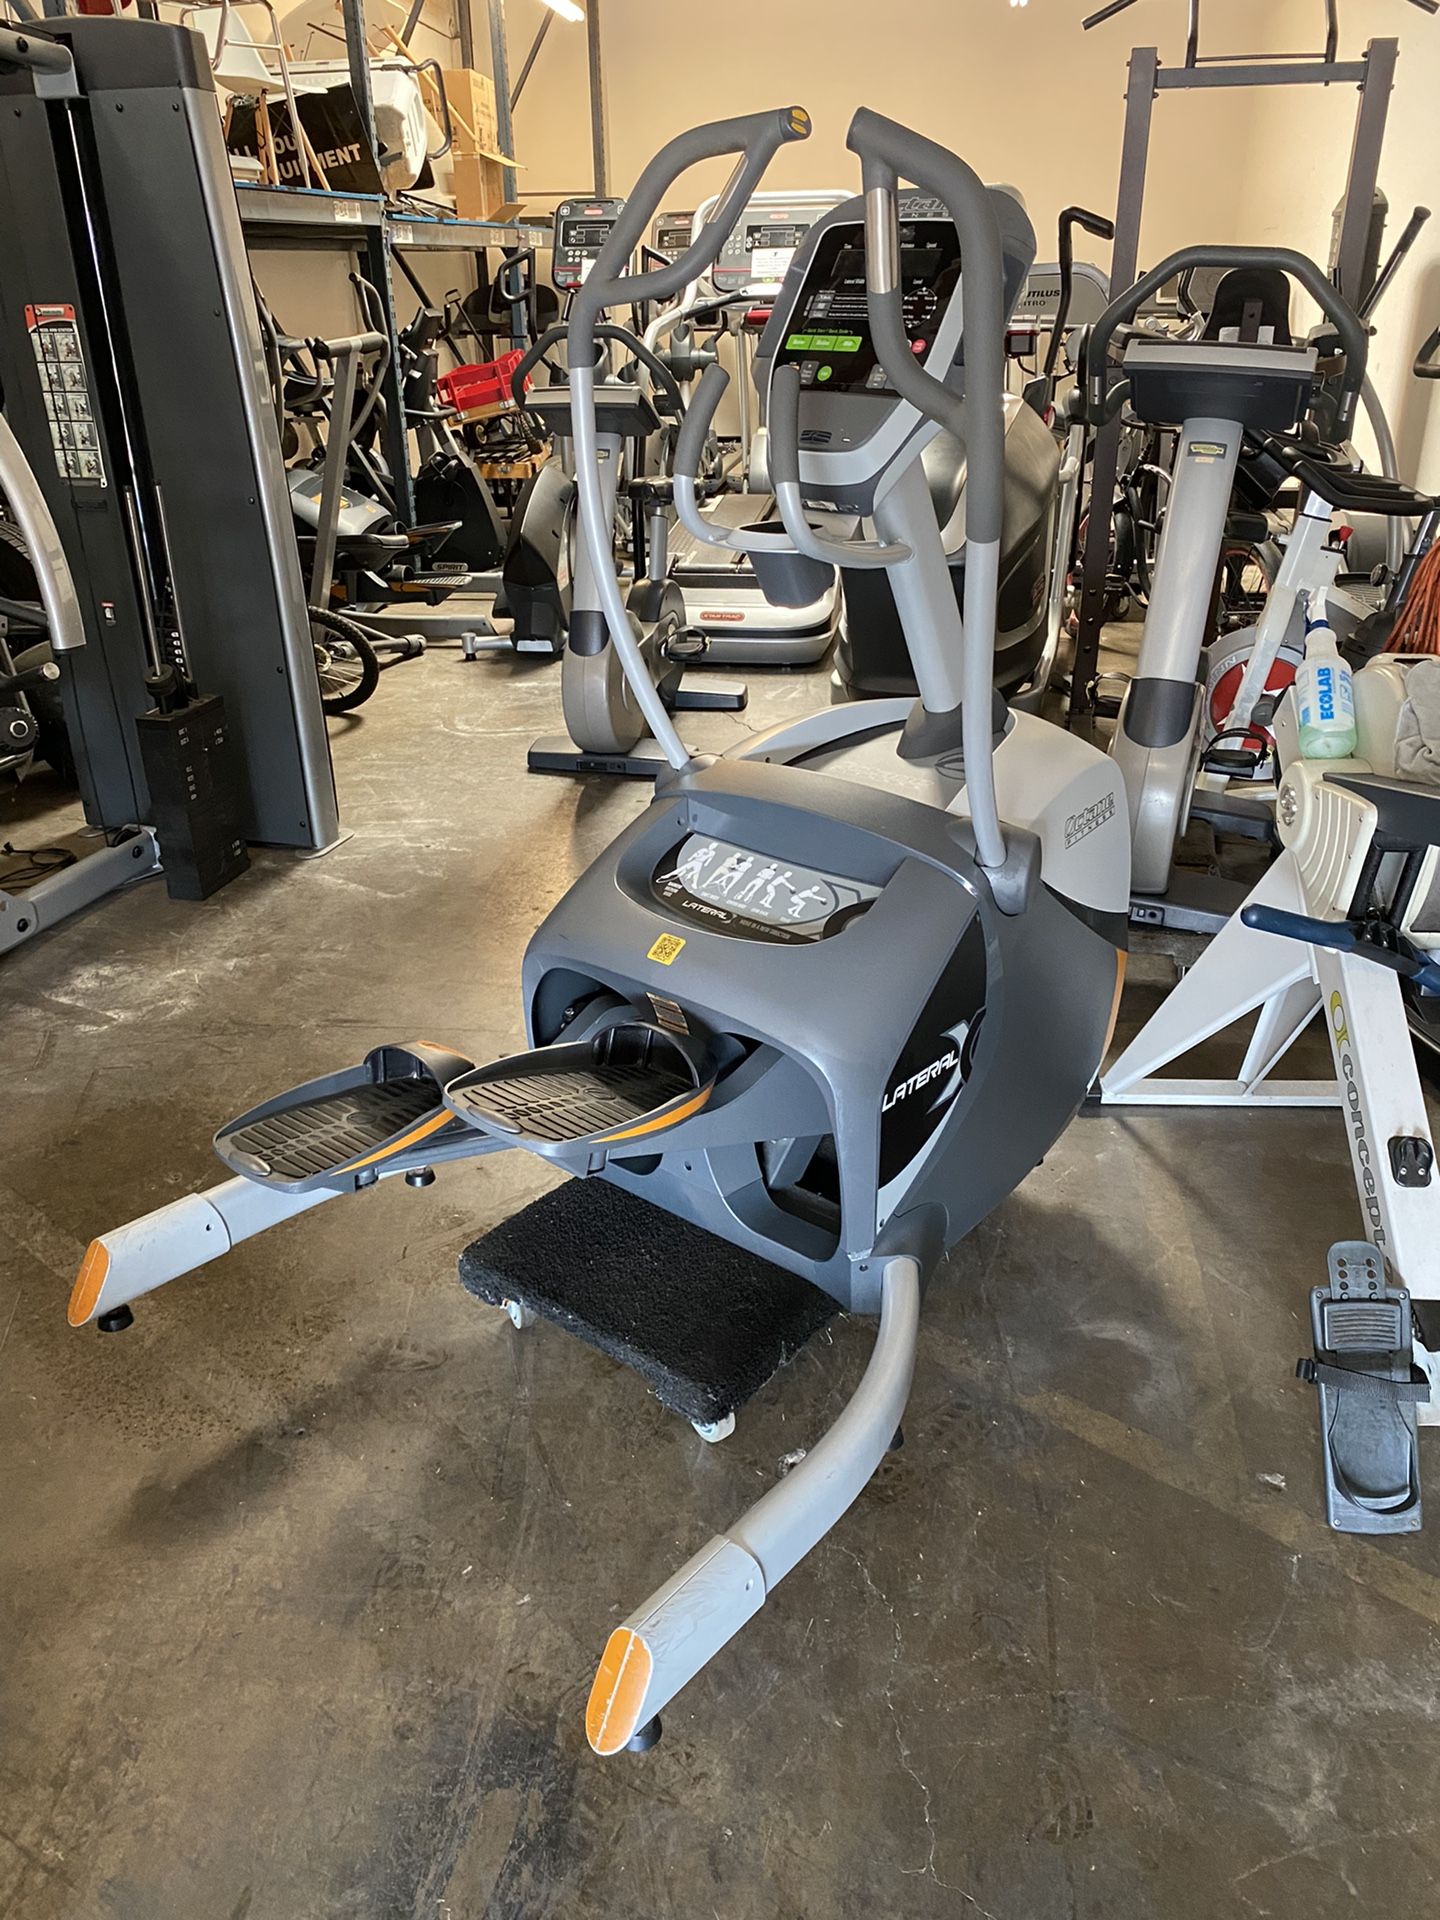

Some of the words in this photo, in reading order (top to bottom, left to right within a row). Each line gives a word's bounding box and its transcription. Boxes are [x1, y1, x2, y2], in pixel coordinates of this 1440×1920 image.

[1317, 667, 1335, 721] ECOLAB
[881, 1050, 959, 1113] LATERAL
[1341, 1053, 1387, 1252] concept
